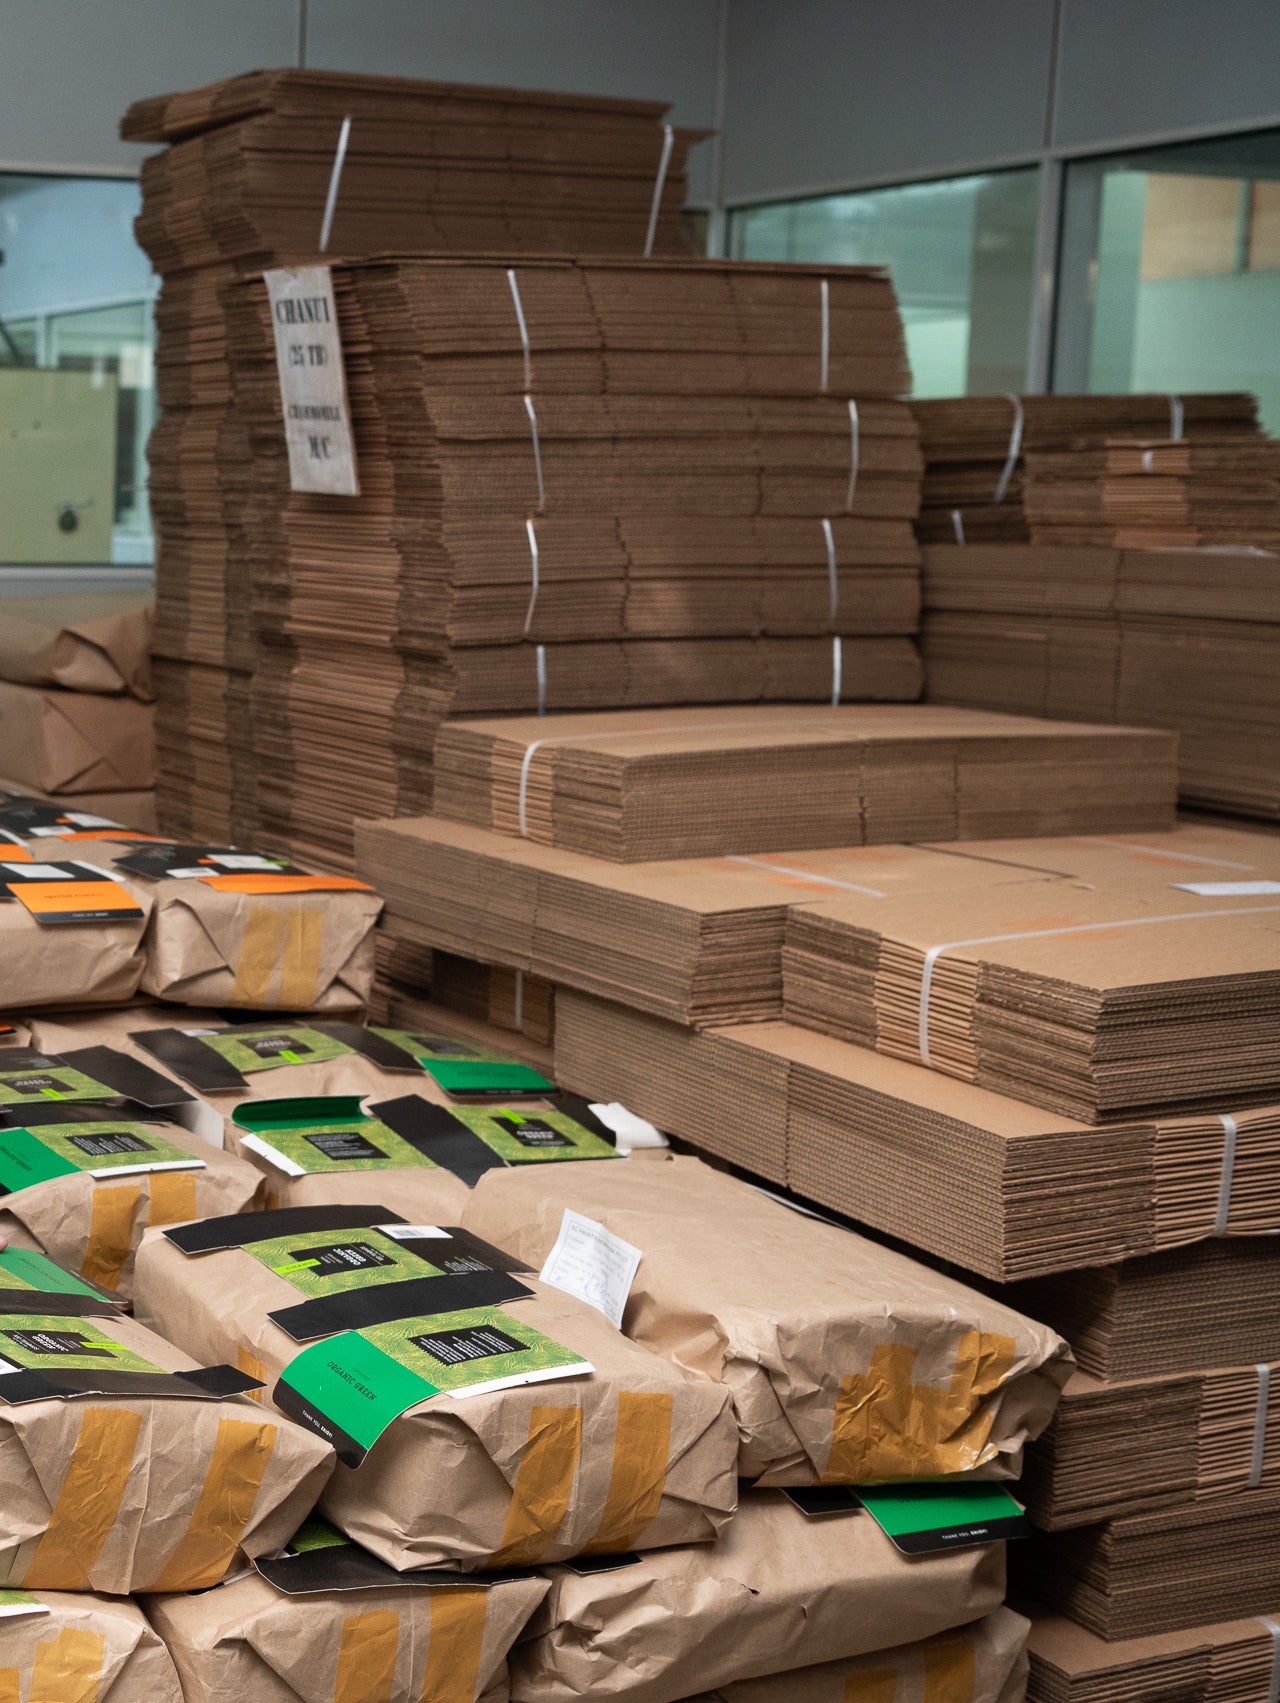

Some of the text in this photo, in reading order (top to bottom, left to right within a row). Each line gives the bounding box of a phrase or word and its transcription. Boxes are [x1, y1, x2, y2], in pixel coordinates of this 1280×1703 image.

[275, 297, 330, 324] CHANUI
[327, 1361, 377, 1401] ORGANIC GREEN
